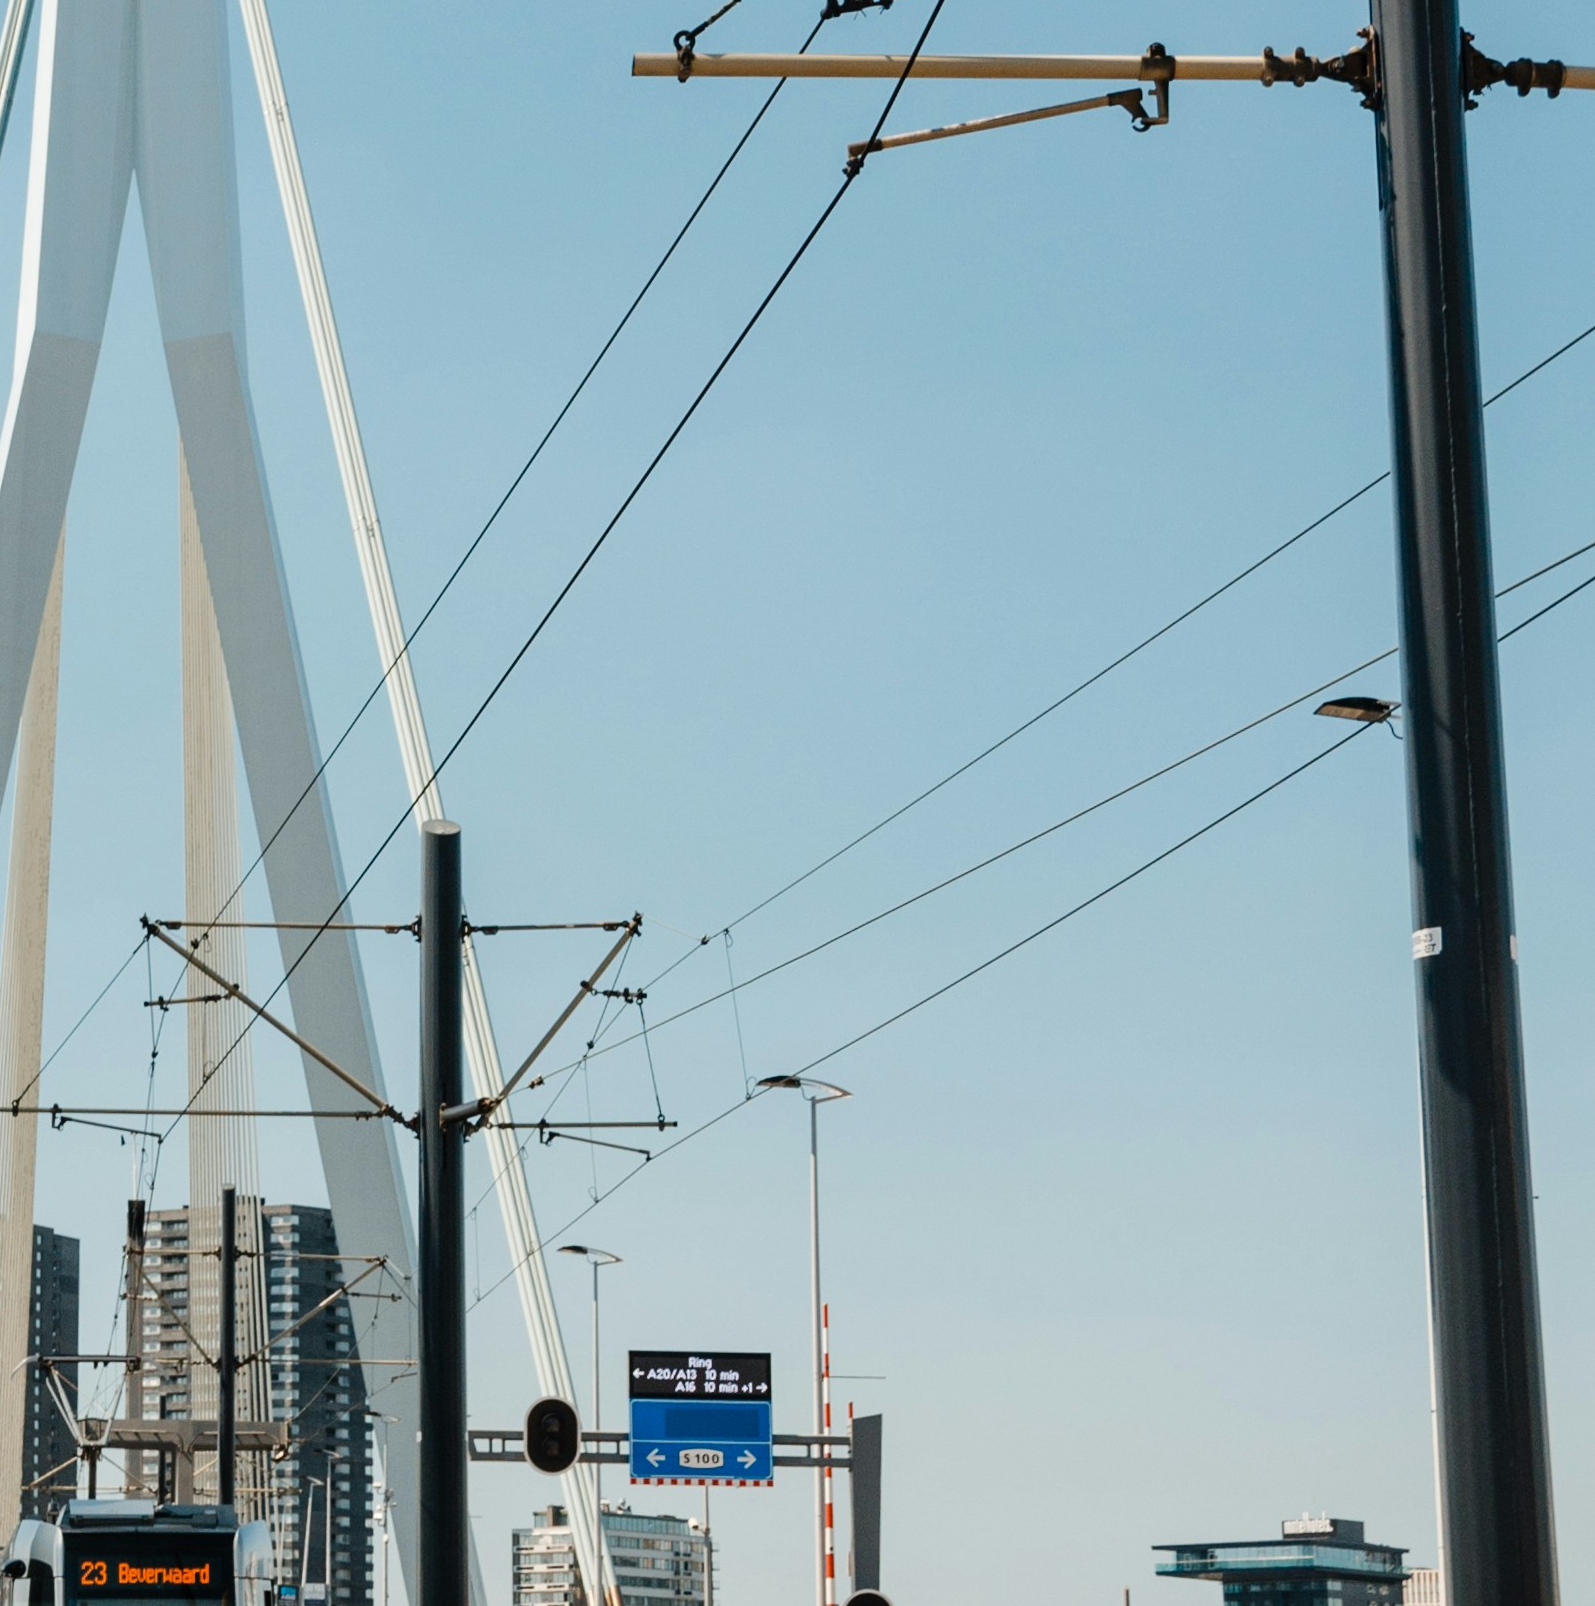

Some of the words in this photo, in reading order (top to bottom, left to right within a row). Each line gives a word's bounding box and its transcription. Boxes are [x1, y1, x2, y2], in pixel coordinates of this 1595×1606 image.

[688, 1356, 713, 1370] Ring
[647, 1368, 697, 1381] A20/A13
[705, 1369, 717, 1381] 10
[719, 1369, 739, 1381] min
[703, 1381, 716, 1393] 10
[718, 1382, 738, 1393] min
[741, 1382, 753, 1394] +1
[81, 1561, 107, 1585] 23
[118, 1562, 210, 1584] Beverwaard
